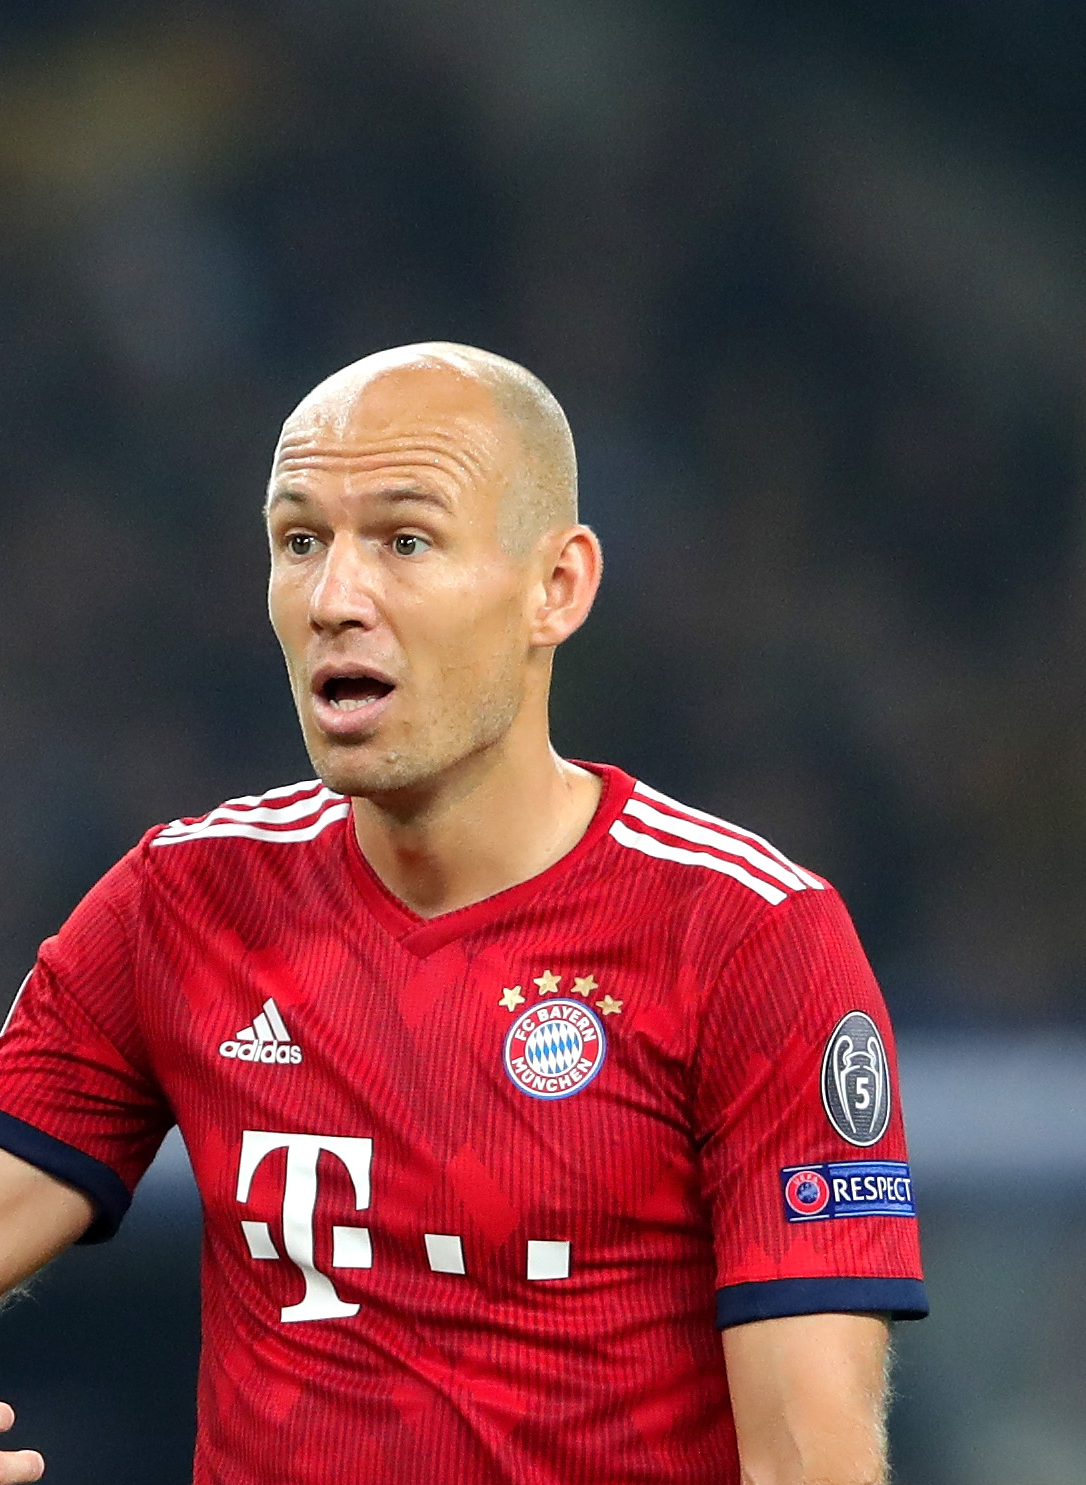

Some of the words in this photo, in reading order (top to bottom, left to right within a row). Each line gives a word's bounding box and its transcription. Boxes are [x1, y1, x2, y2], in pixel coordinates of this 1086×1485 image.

[515, 1018, 536, 1042] FC
[536, 1005, 597, 1042] BAYERN
[218, 1040, 303, 1065] adidas
[511, 1056, 593, 1092] MÜNCHEN
[855, 1077, 870, 1110] 5
[833, 1176, 911, 1202] RESPECT
[236, 1130, 374, 1323] T
